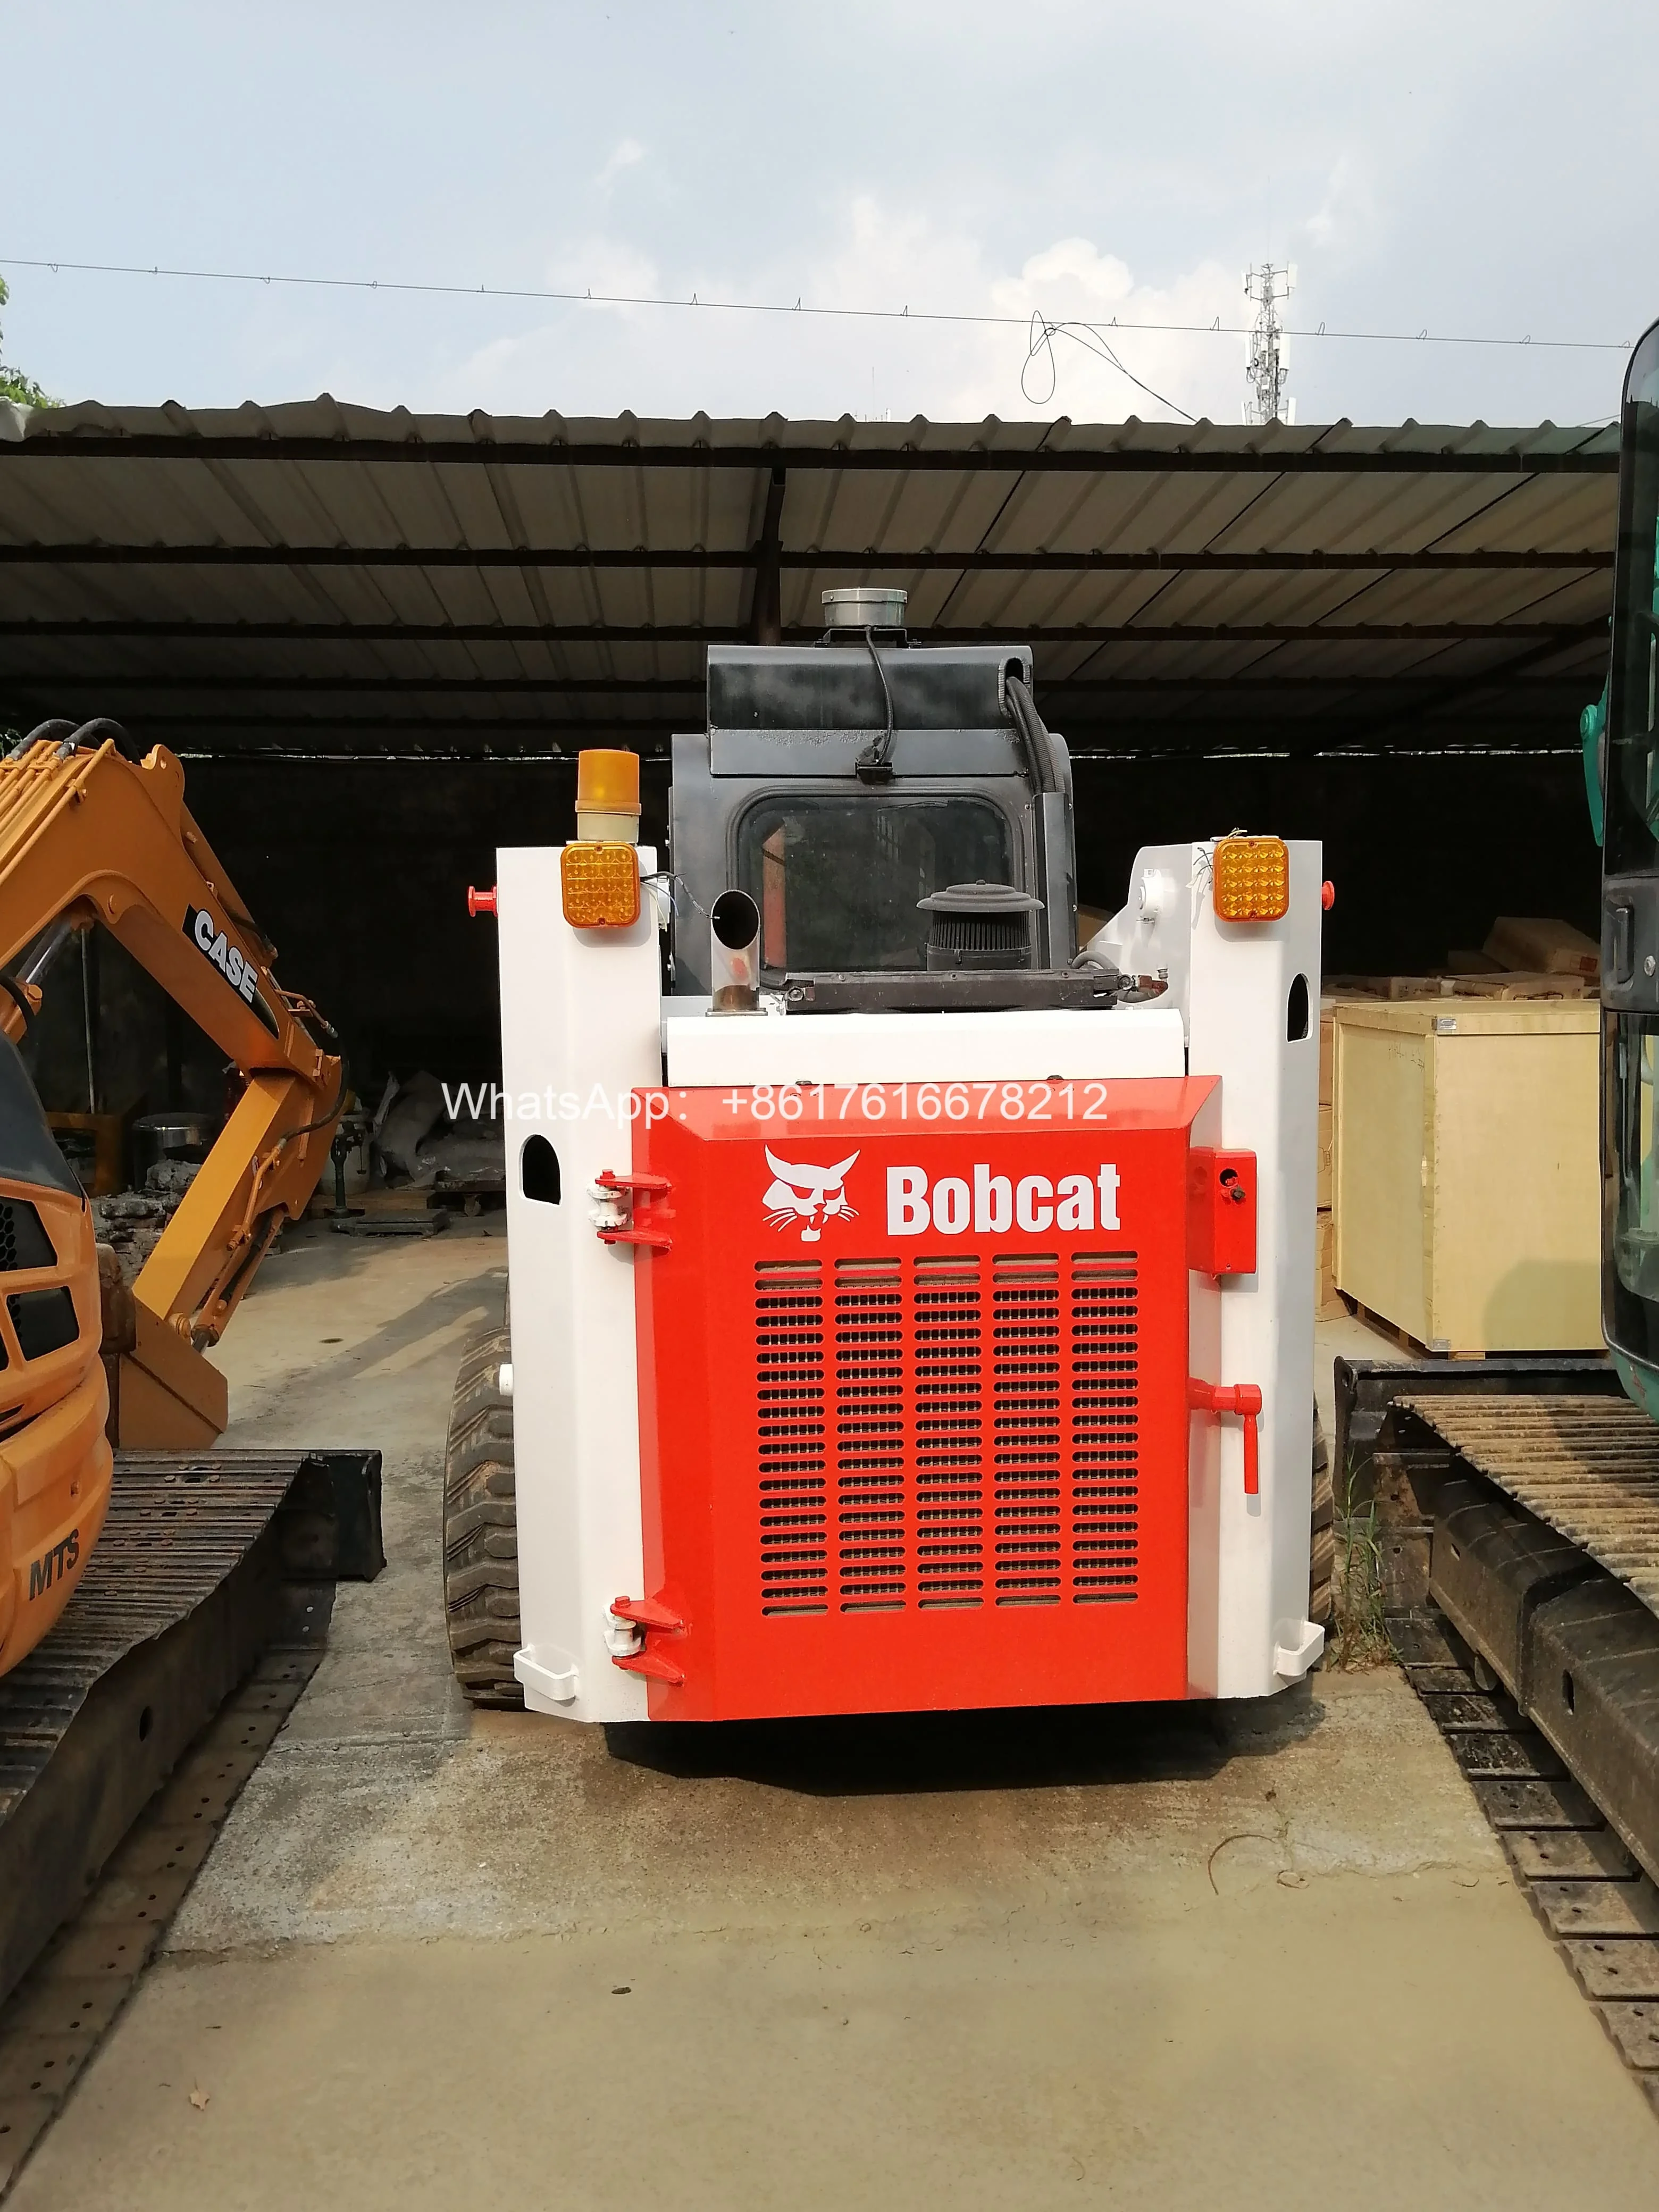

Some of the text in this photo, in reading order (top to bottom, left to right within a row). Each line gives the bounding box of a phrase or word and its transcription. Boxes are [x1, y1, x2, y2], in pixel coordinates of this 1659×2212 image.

[195, 910, 258, 1003] CASE
[887, 1163, 1120, 1236] Bobcat
[29, 1528, 80, 1602] MTS
